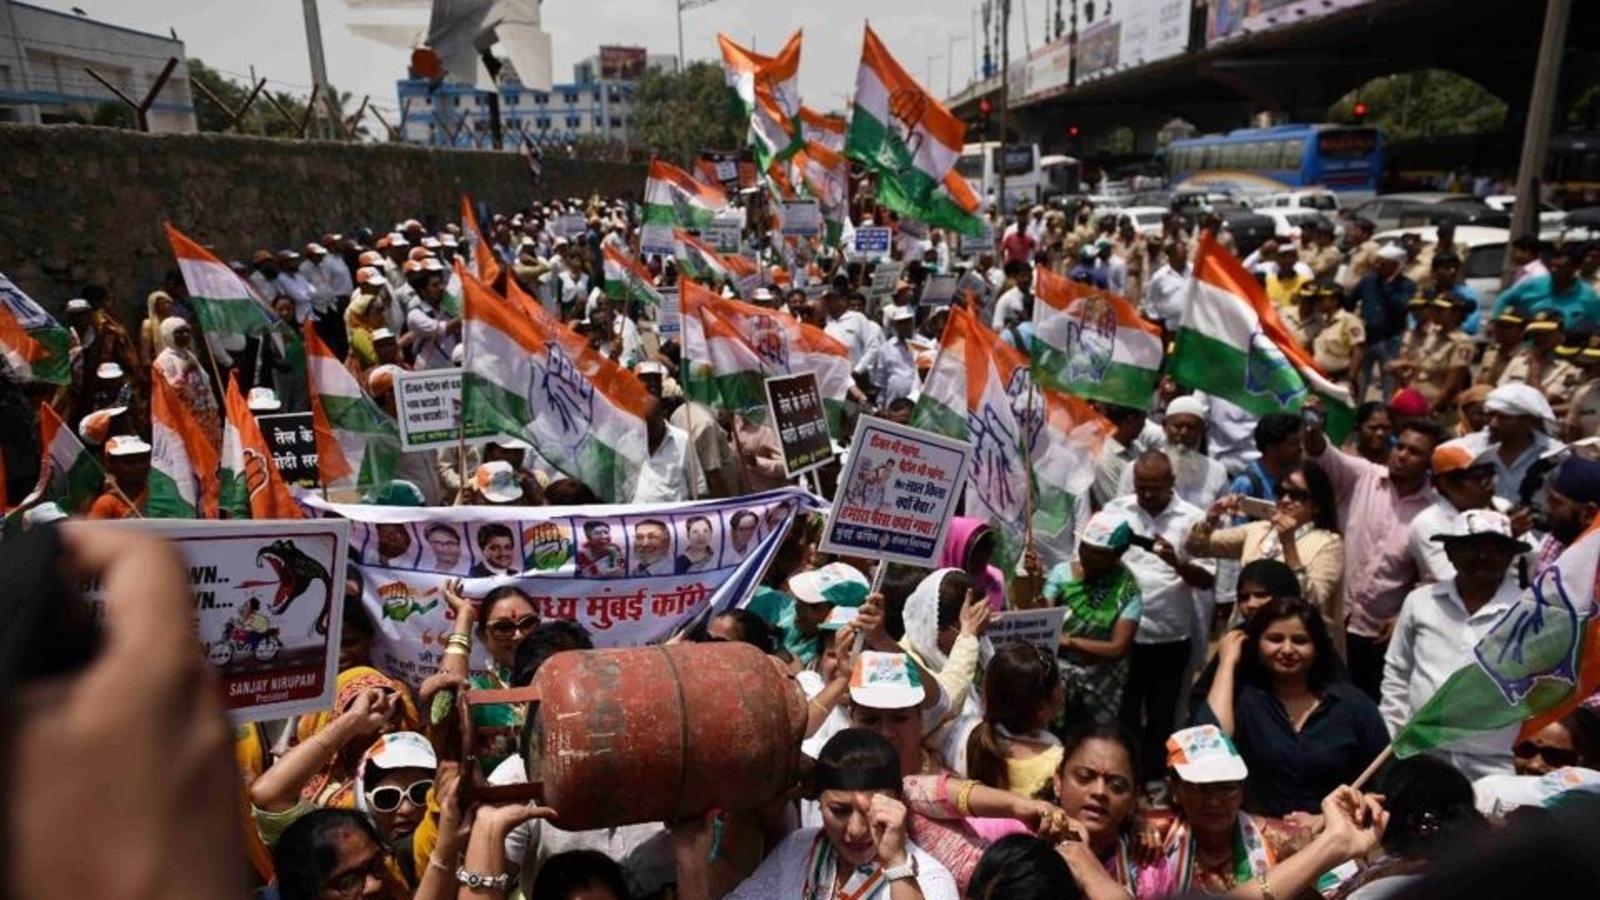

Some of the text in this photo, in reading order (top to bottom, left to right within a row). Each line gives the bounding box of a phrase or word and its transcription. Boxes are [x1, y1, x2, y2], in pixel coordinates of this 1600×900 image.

[274, 425, 314, 445] तेल के
[301, 454, 320, 467] सर
[586, 587, 647, 629] मुंबई
[229, 673, 316, 696] SANJAY NIRUPAM
